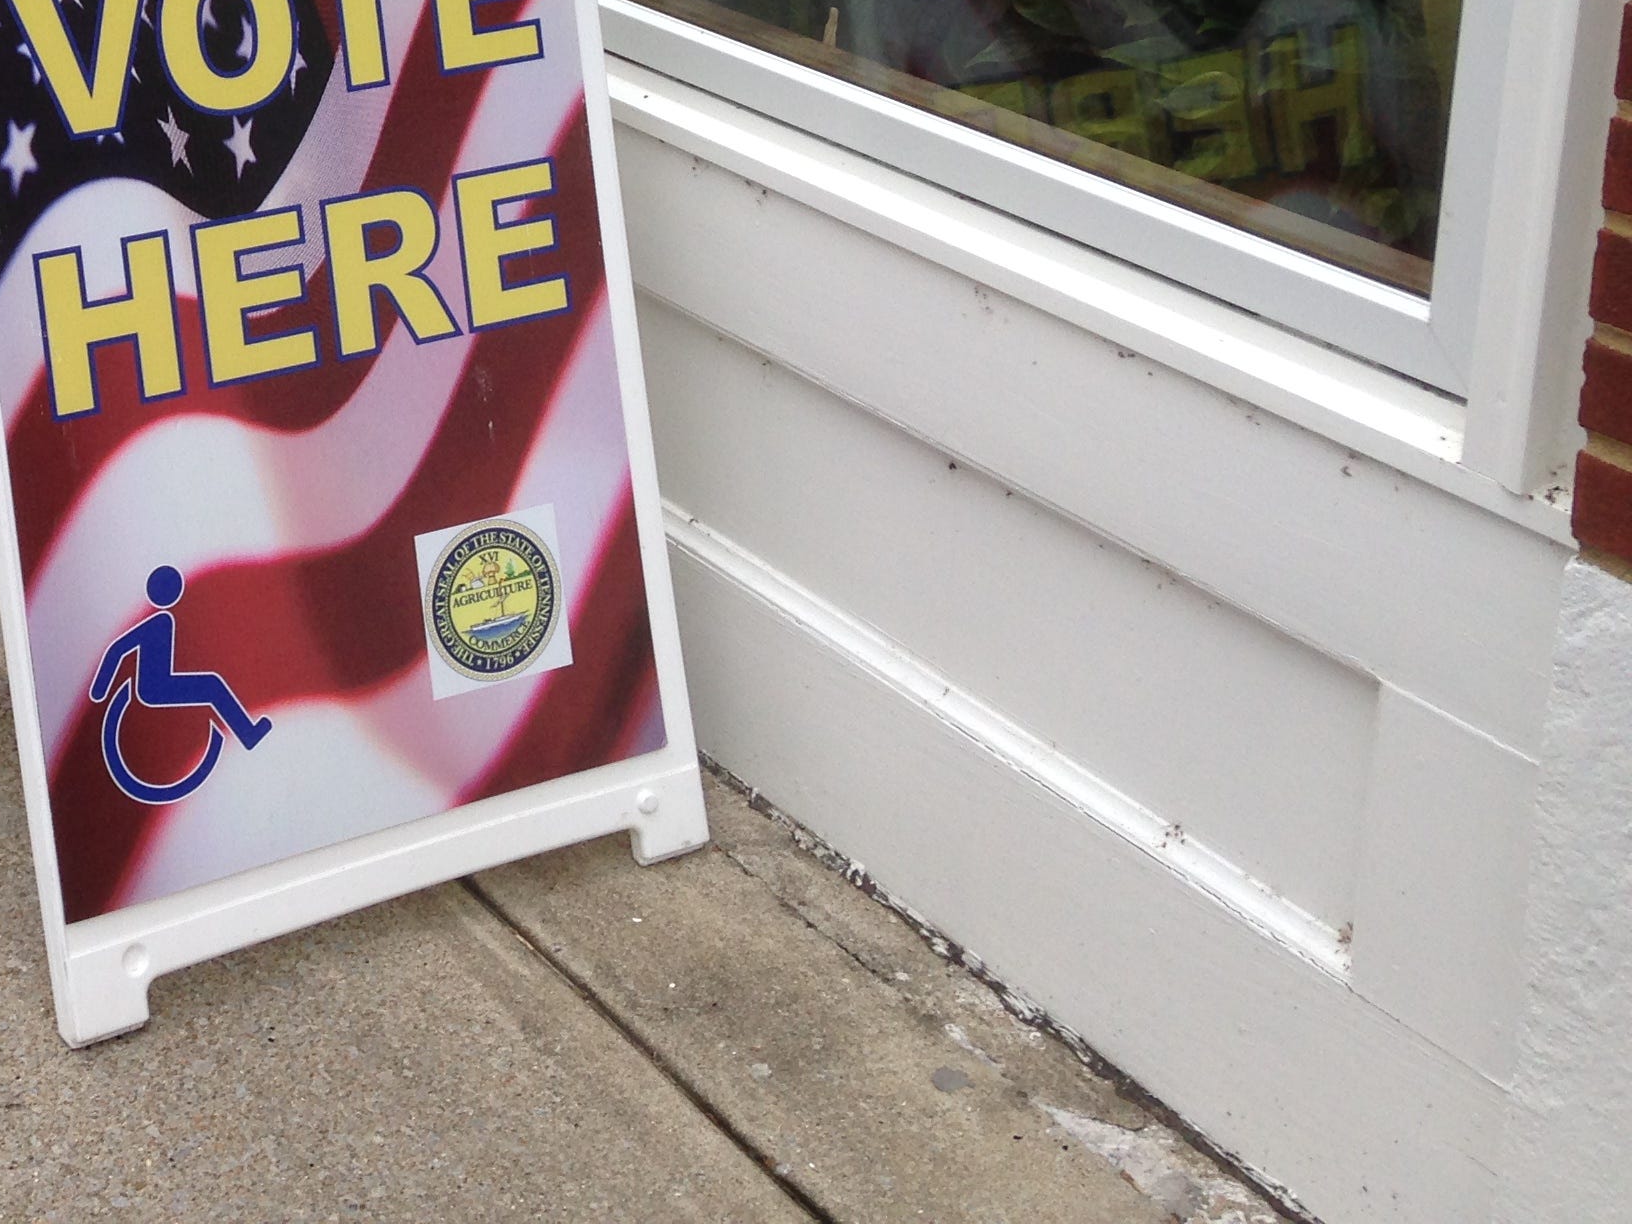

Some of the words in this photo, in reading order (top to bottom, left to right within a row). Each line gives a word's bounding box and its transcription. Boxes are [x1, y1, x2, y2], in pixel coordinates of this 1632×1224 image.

[32, 156, 570, 423] HERE
[437, 563, 458, 597] SEAL
[471, 531, 498, 548] THE
[478, 550, 500, 565] XVI
[452, 579, 533, 609] AGRICULTURE
[485, 653, 515, 670] 1796
